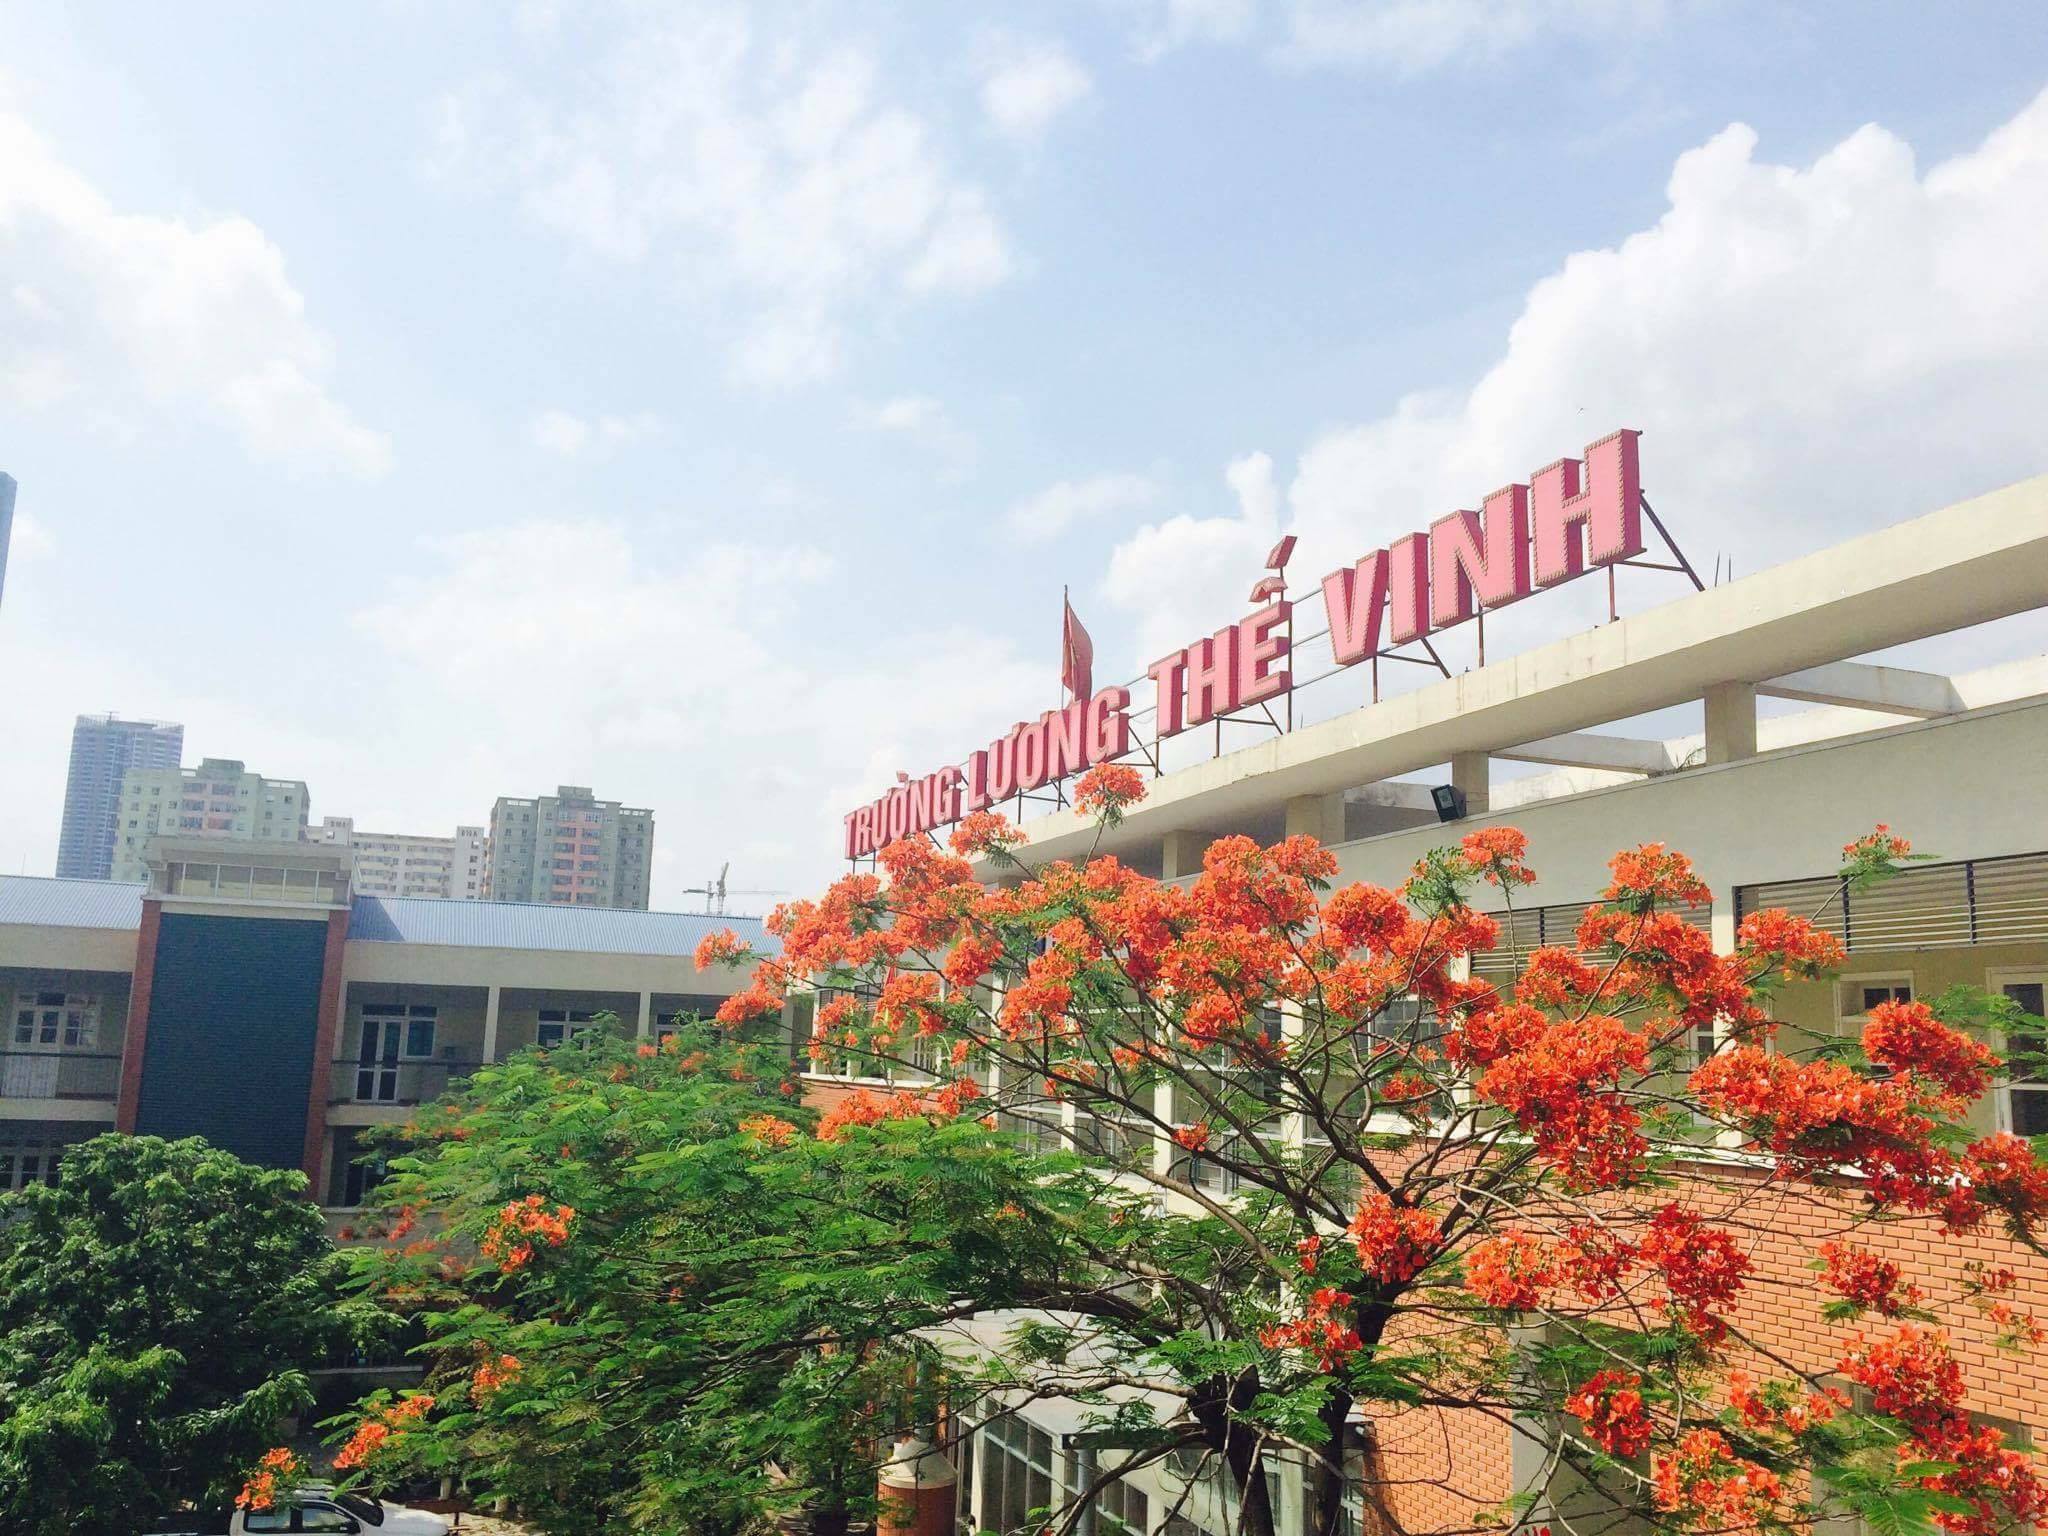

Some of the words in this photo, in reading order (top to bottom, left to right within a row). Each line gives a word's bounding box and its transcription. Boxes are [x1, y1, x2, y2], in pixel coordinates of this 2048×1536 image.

[844, 766, 962, 859] TRƯỜNG
[968, 686, 1130, 811] LƯƠNG
[1147, 535, 1297, 737] THẾ
[1321, 428, 1643, 665] VINH
